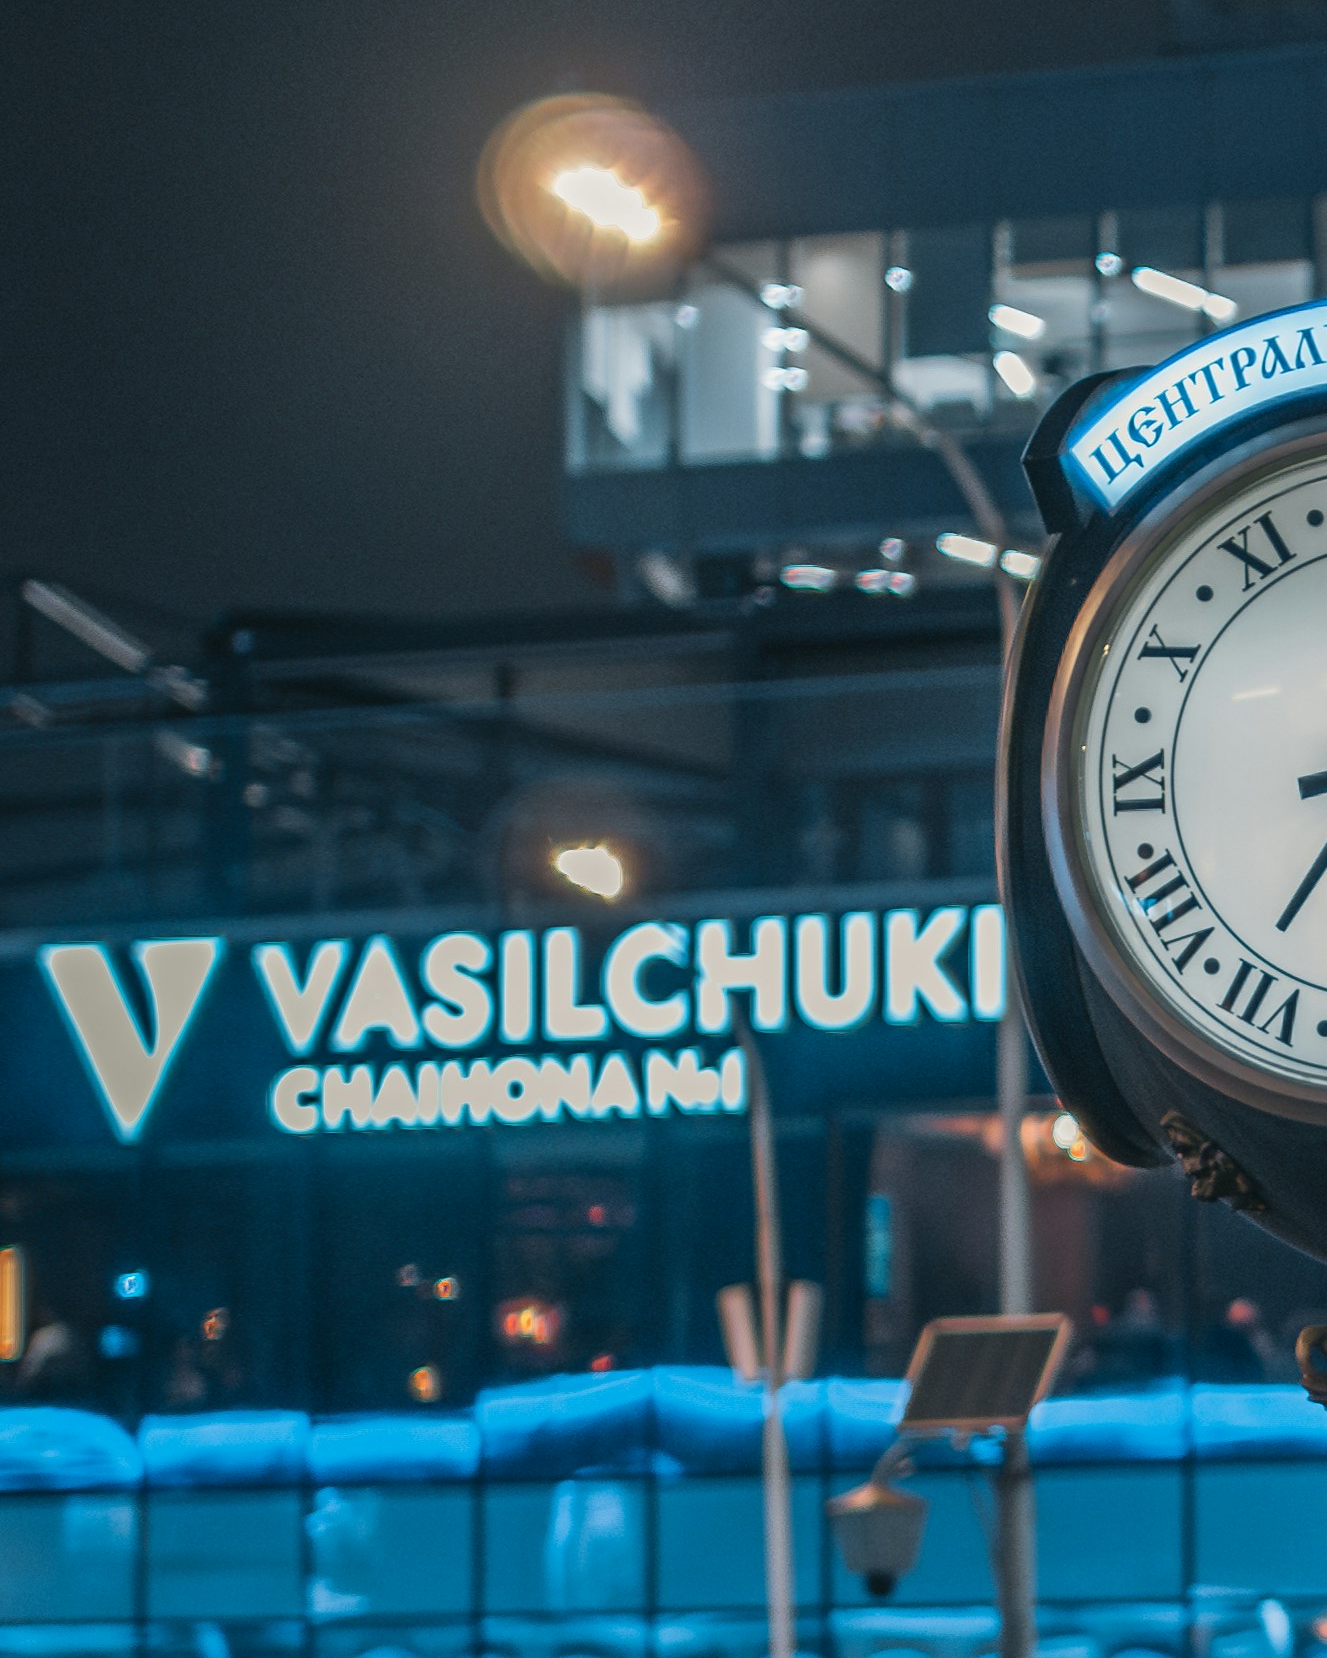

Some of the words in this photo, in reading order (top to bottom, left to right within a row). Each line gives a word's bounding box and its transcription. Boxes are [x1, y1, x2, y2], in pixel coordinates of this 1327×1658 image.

[1217, 510, 1297, 592] XI
[1137, 623, 1201, 683] X
[1112, 747, 1166, 817] IX
[1124, 847, 1216, 976] VIII
[253, 903, 1007, 1056] VASILCHUKI
[1216, 957, 1301, 1048] VII
[40, 938, 226, 1143] V
[270, 1047, 642, 1137] CHAIHONA
